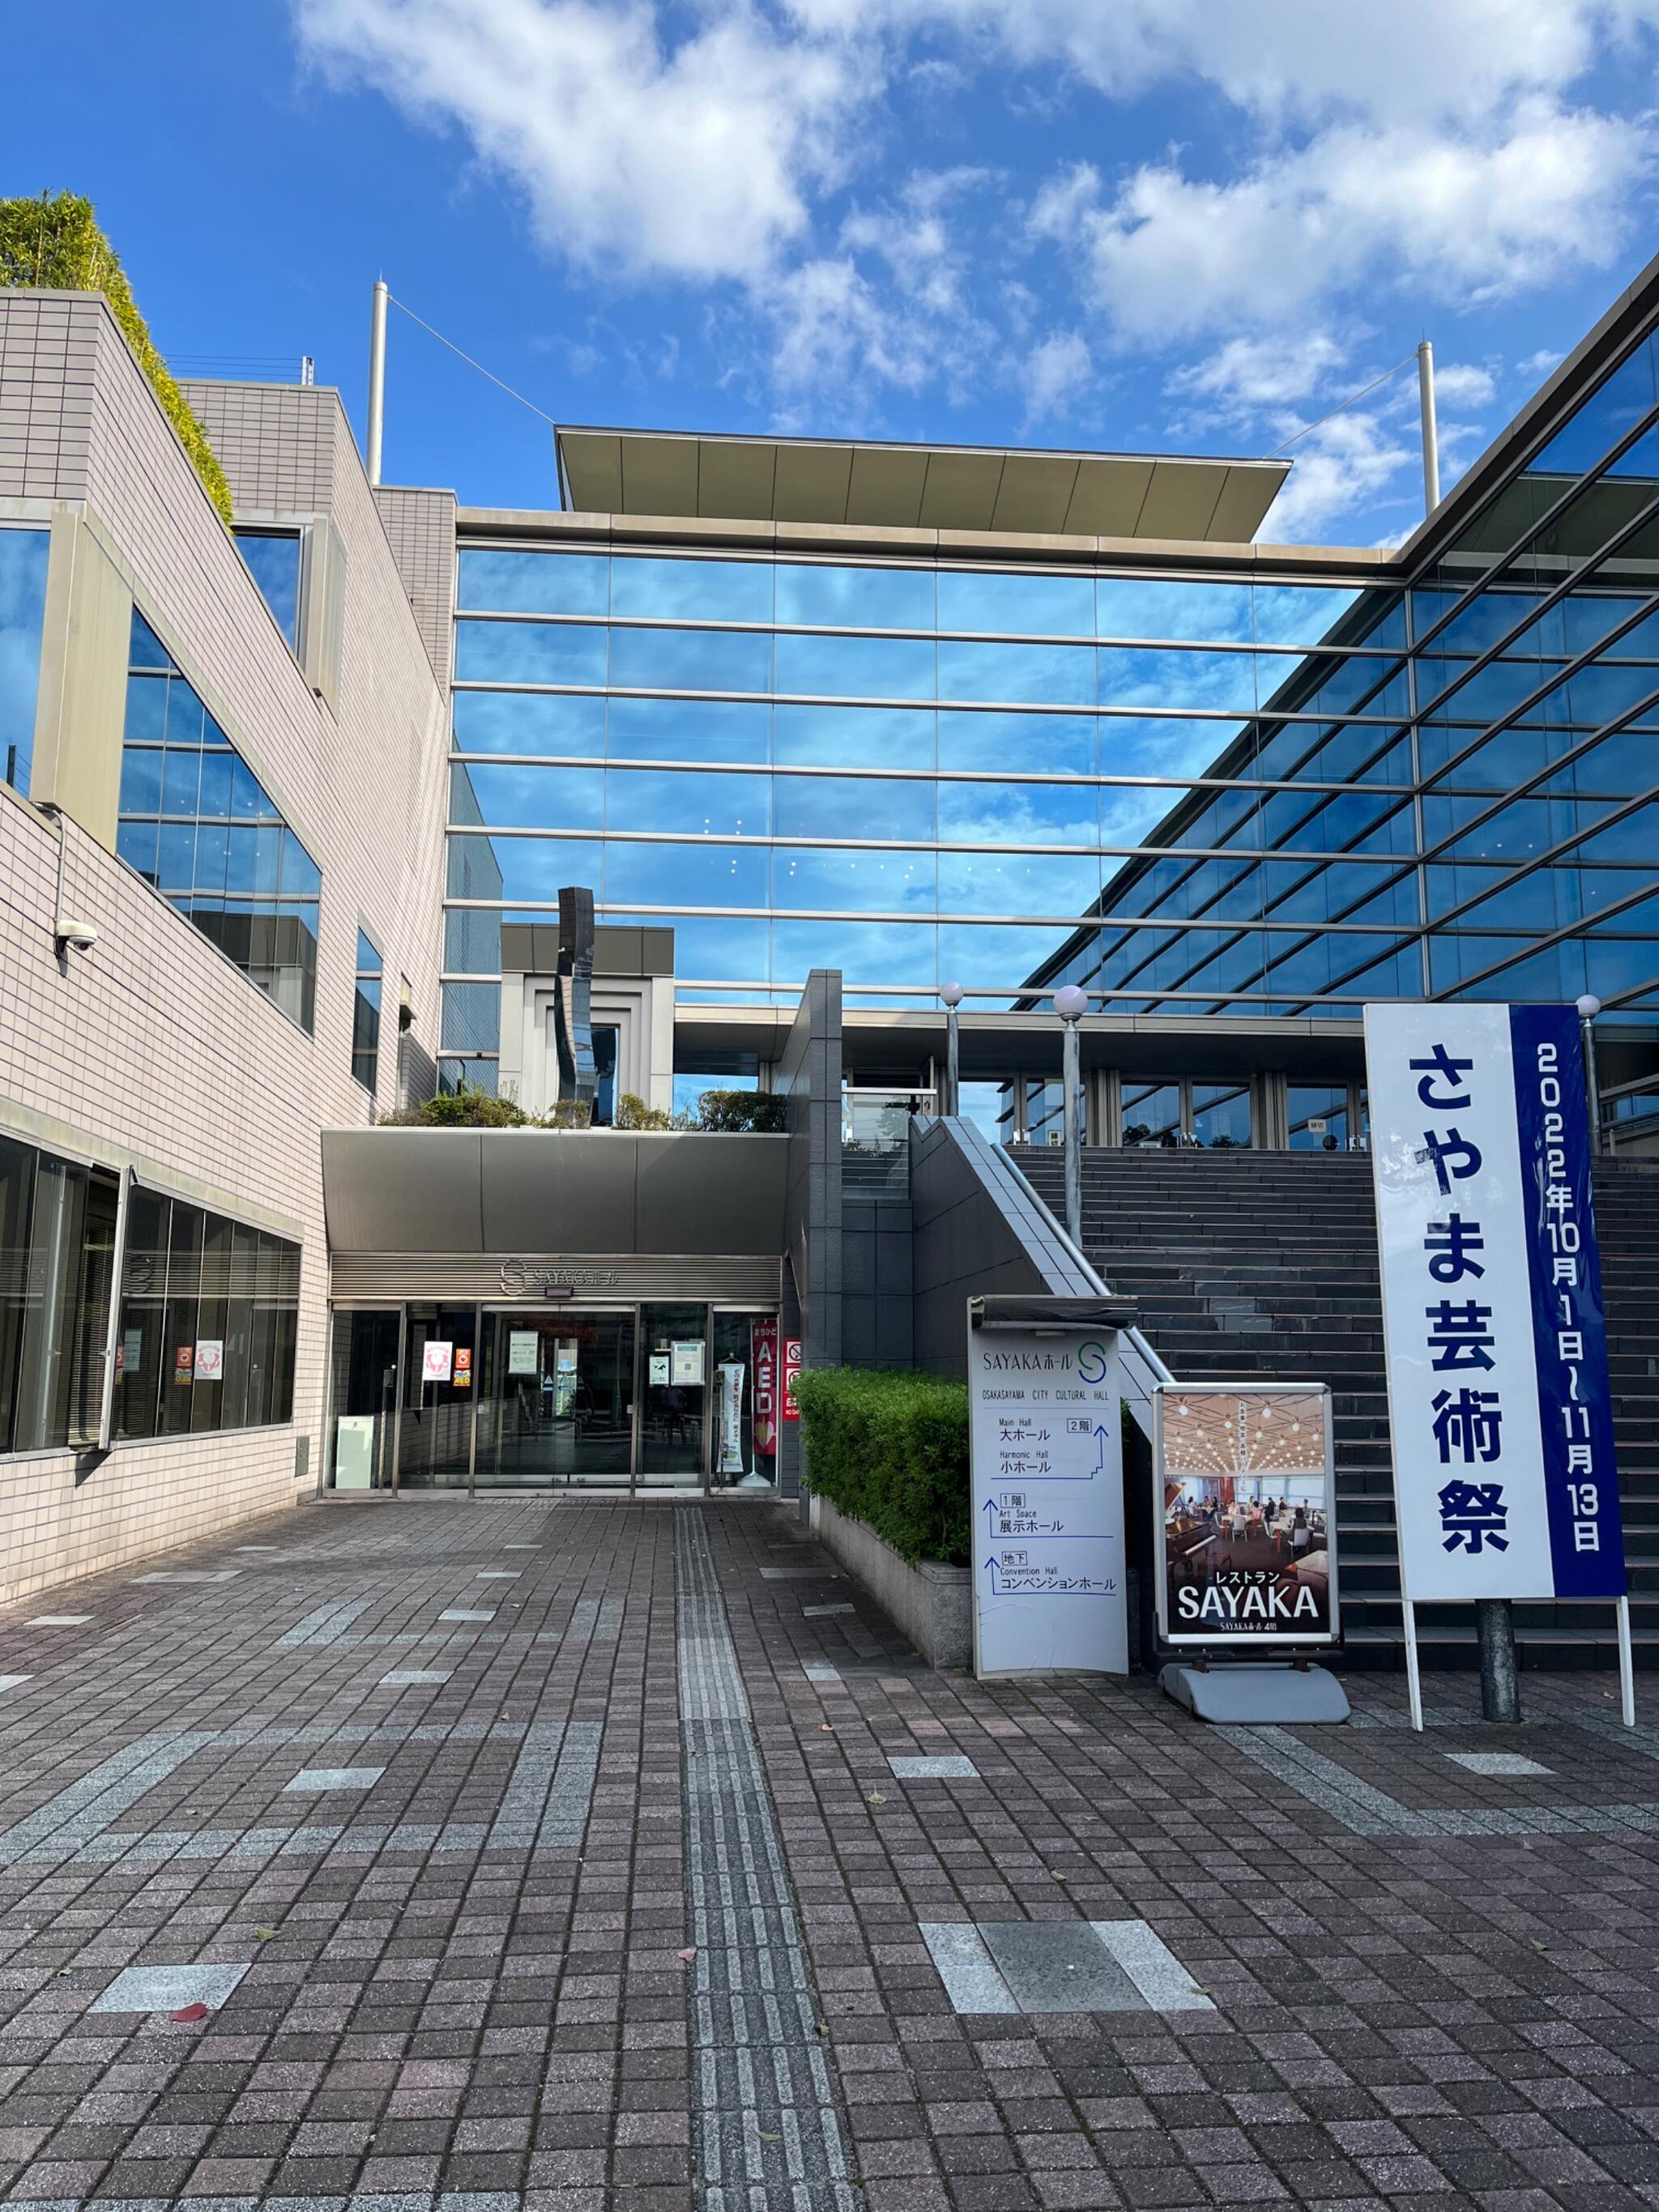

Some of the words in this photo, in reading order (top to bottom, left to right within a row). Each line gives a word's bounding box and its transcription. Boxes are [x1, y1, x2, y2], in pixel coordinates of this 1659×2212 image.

[1410, 1042, 1510, 1554] さやま芸術祭
[756, 1341, 772, 1414] AED
[983, 1389, 1025, 1400] OSAKASAYAMA
[1032, 1389, 1048, 1400] CITY
[1056, 1389, 1086, 1400] CULTURAL
[1094, 1389, 1109, 1400] HALL
[999, 1418, 1014, 1426] Main
[1019, 1418, 1032, 1426] Hall
[1071, 1421, 1090, 1431] 2階
[1000, 1428, 1051, 1441] 大ホール
[1000, 1451, 1030, 1459] Harmonic
[1036, 1451, 1049, 1459] Hall
[1000, 1460, 1051, 1473] 小ホール
[1004, 1495, 1022, 1507] 1階
[999, 1510, 1011, 1518] Art
[1016, 1509, 1037, 1519] Space
[1000, 1519, 1064, 1533] 展示ホール
[1004, 1553, 1025, 1564] 地下
[1000, 1567, 1040, 1575] Convention
[1045, 1566, 1057, 1575] Hall
[1001, 1577, 1117, 1590] コンベンションホール
[1216, 1571, 1280, 1584] レストラン
[1178, 1585, 1319, 1618] SAYAKA
